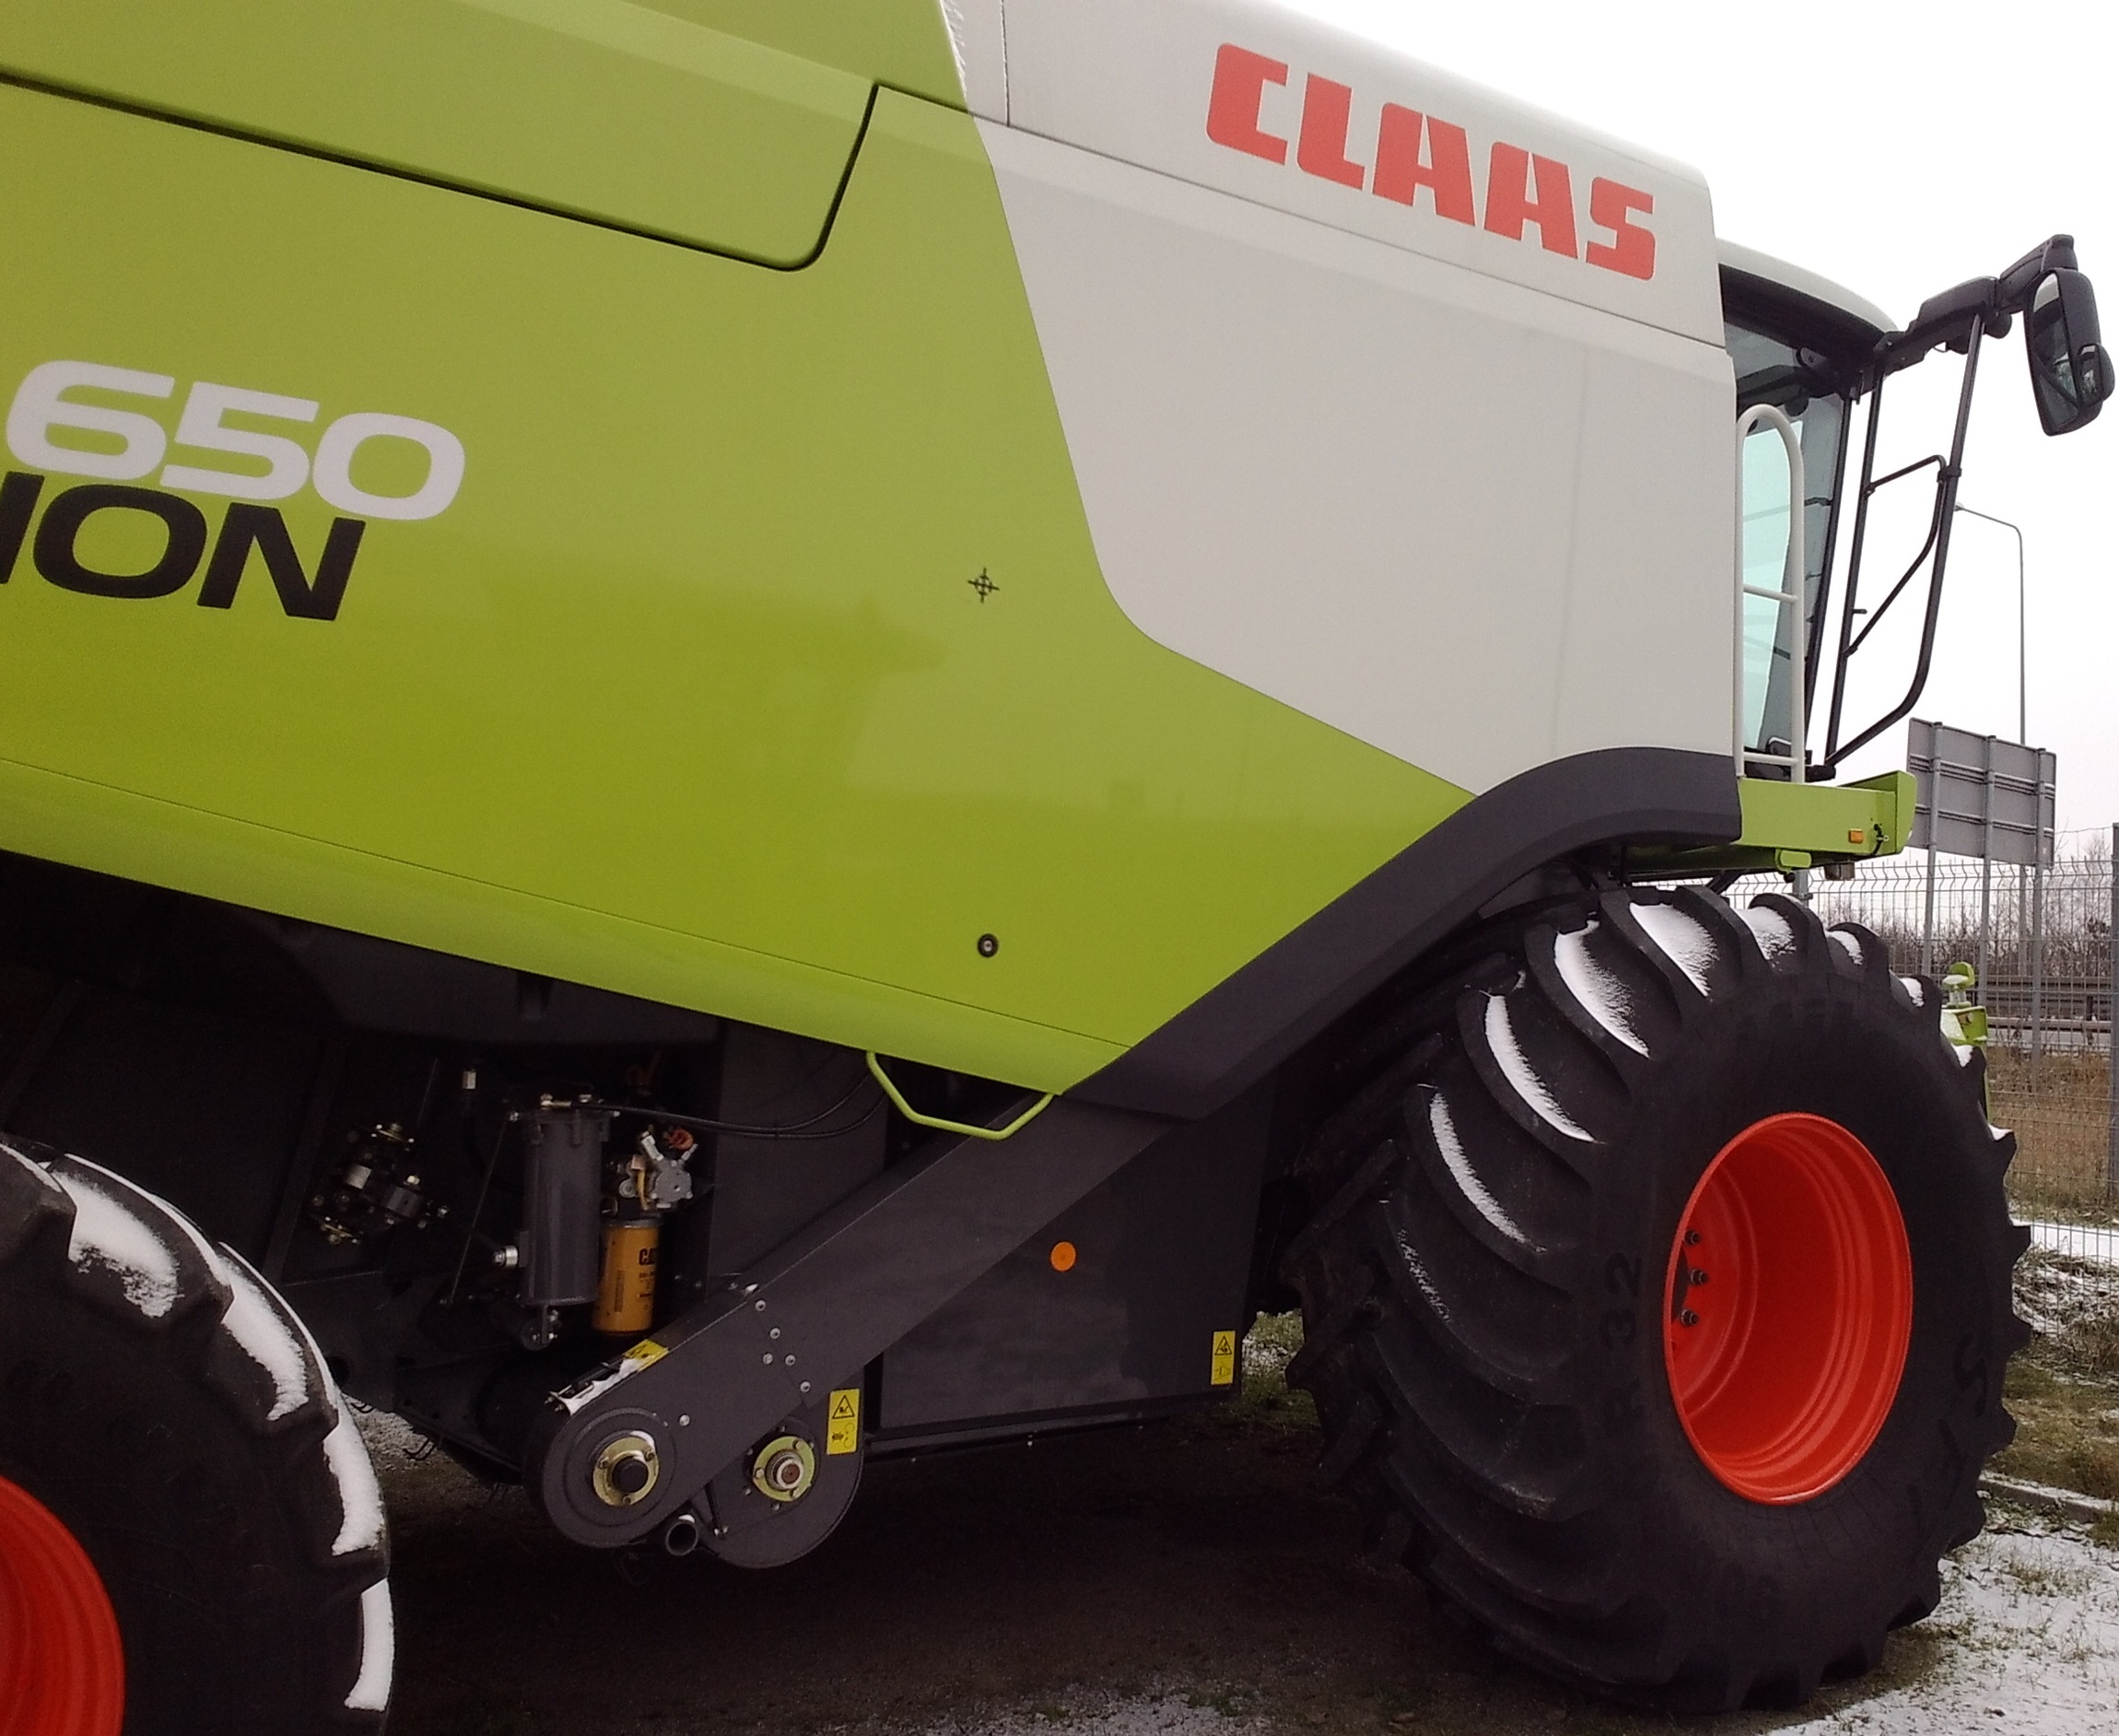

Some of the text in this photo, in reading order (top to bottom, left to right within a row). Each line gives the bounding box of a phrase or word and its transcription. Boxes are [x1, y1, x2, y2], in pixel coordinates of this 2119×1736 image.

[1206, 42, 1656, 281] CLAAS
[6, 360, 465, 521] 650
[0, 471, 367, 621] ION
